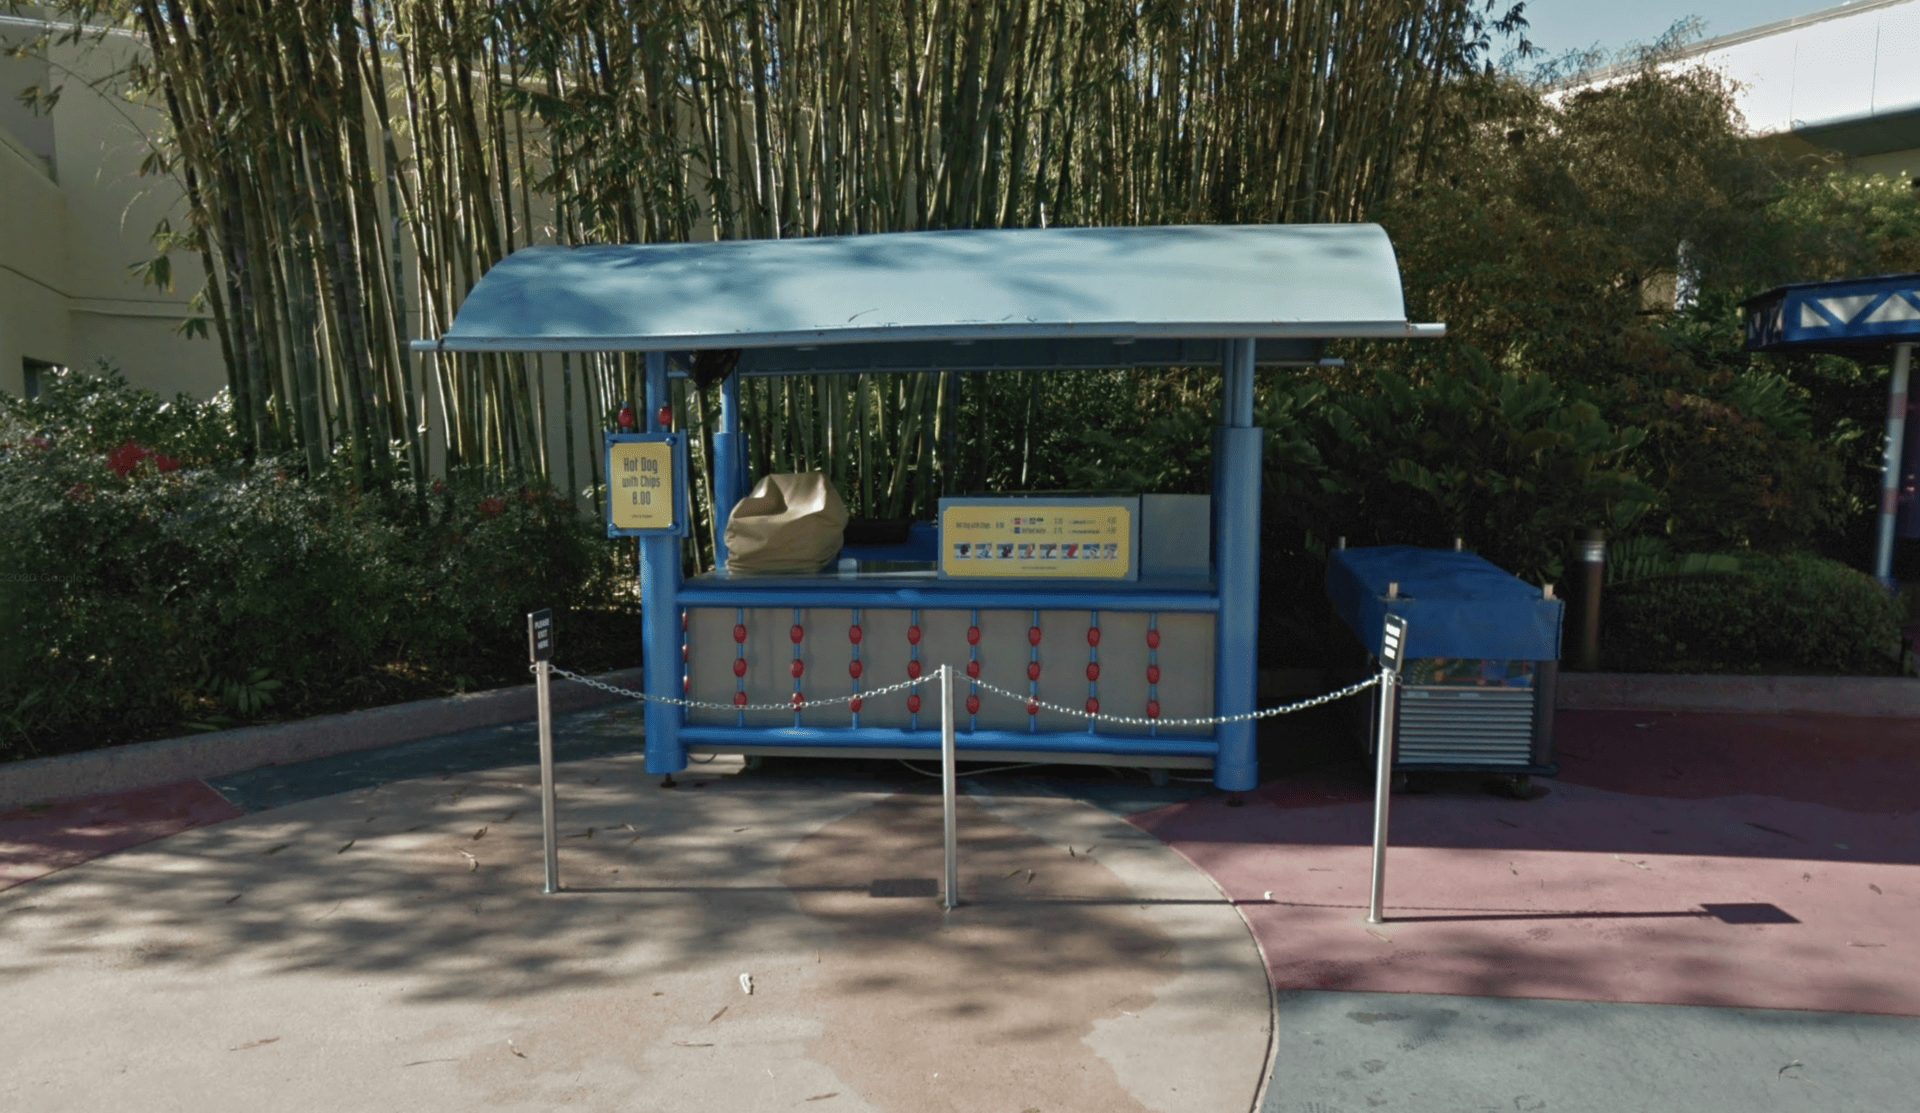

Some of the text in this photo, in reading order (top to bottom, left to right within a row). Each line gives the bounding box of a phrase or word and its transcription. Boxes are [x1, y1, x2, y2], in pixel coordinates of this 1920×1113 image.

[623, 457, 658, 474] Hot Dog
[622, 475, 661, 489] with Chips
[632, 491, 651, 505] 8.00
[535, 618, 549, 629] PLEASE
[537, 629, 547, 639] EXIT
[537, 639, 548, 649] HERE
